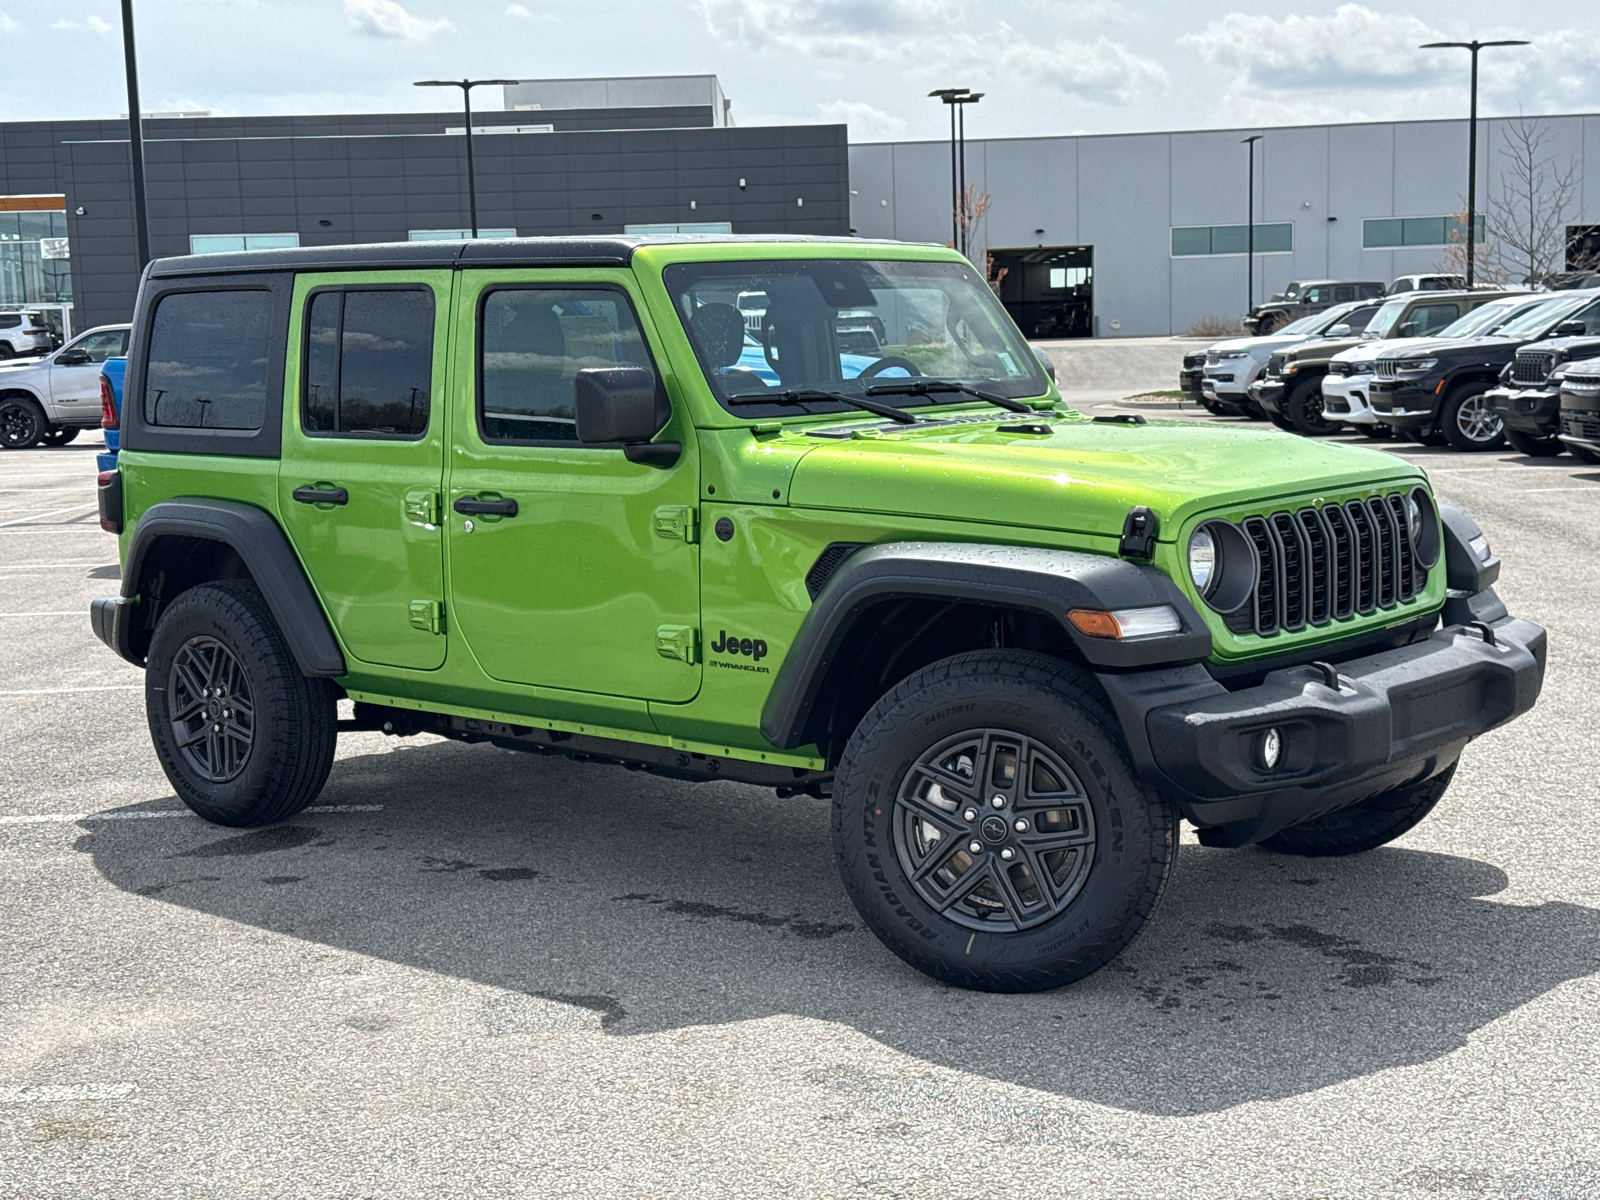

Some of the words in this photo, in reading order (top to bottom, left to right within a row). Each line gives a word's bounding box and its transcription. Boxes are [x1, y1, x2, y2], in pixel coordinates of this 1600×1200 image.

[711, 630, 768, 662] Jeep
[717, 661, 770, 674] WRANGLER
[923, 702, 977, 727] 245/75R17
[862, 778, 881, 848] HTX2
[1072, 739, 1124, 853] NEXEN
[866, 852, 939, 942] ROADIAN
[1036, 918, 1090, 956] All-Weather
